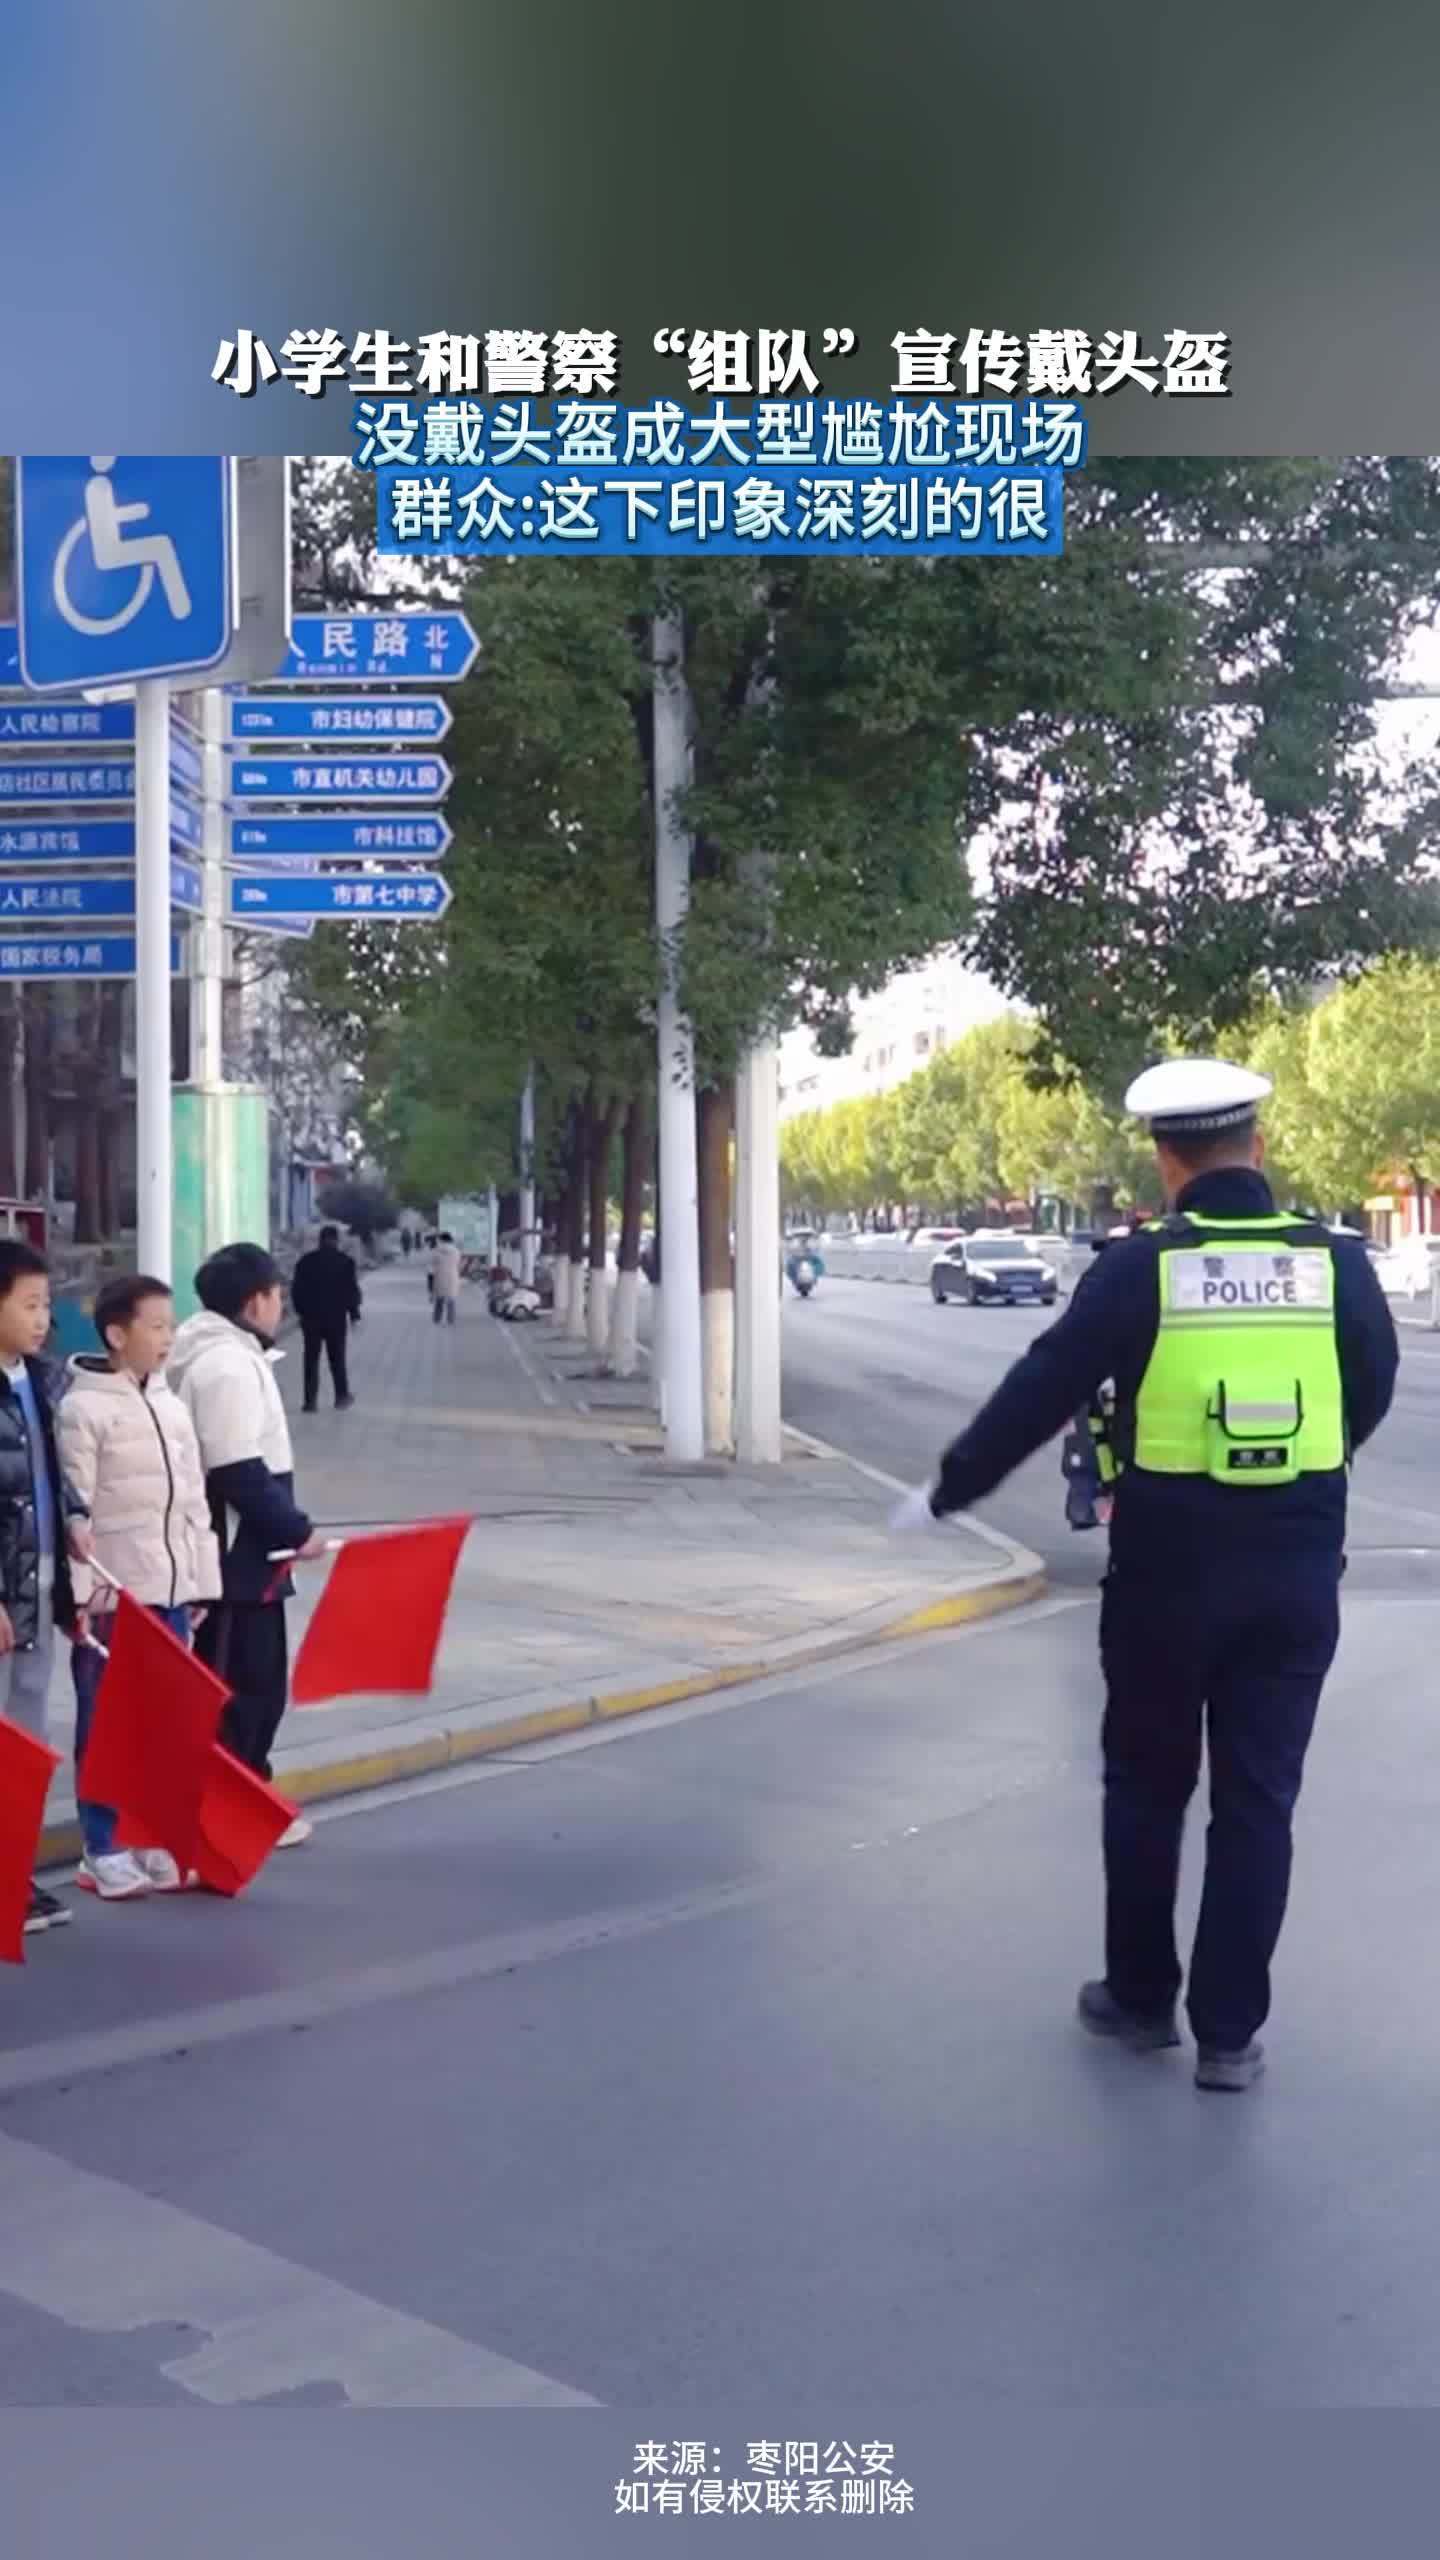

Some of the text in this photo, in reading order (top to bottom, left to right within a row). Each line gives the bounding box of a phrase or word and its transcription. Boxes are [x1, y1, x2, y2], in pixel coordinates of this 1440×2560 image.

[312, 706, 437, 730] 市妇幼保健院
[293, 766, 438, 789] 市直机关幼儿园
[333, 884, 438, 906] 市第七中学
[1203, 1280, 1297, 1304] POLICE
